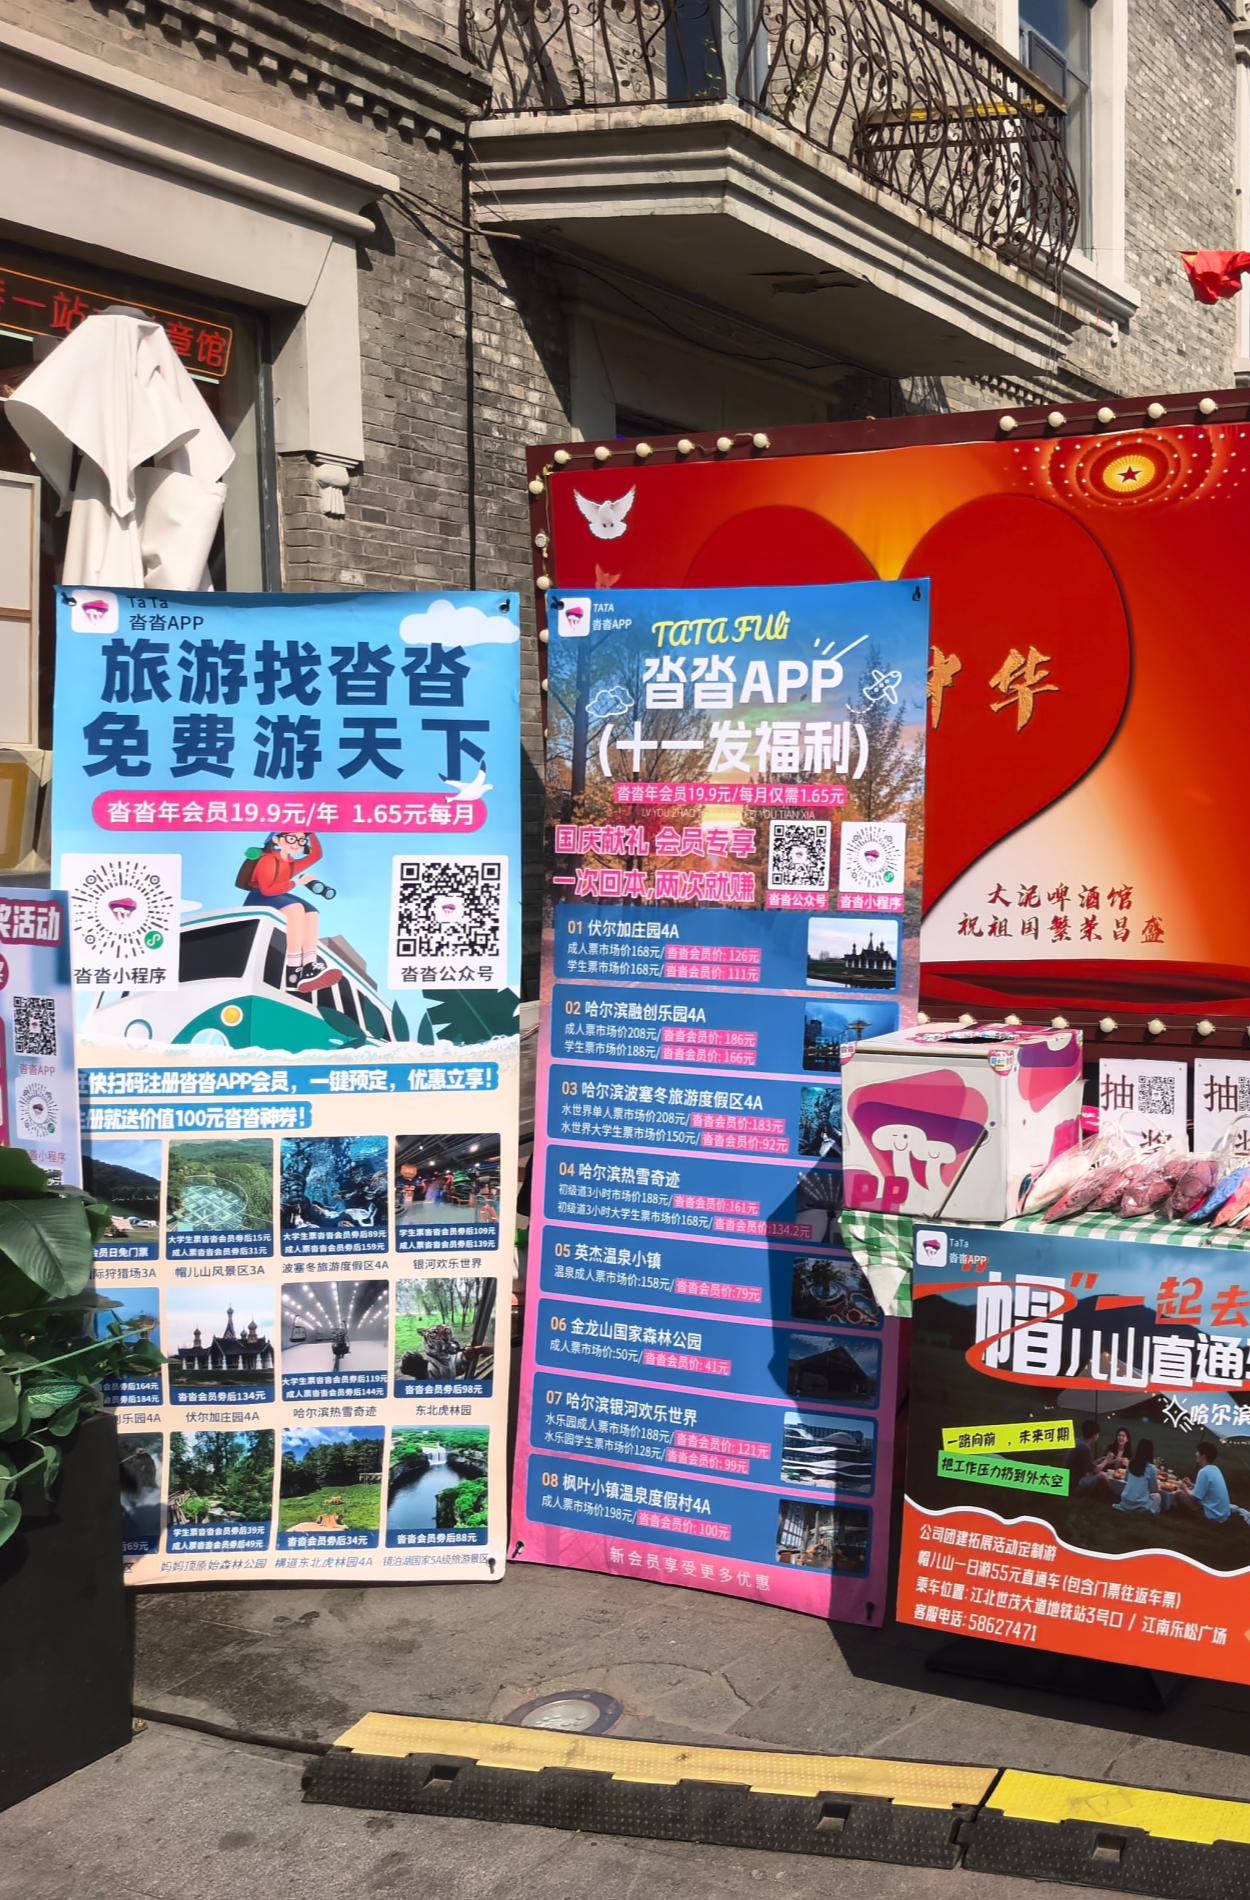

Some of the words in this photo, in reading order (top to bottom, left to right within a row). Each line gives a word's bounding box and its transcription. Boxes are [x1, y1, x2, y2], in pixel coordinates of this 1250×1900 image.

[593, 604, 614, 612] TATA
[129, 615, 204, 631] 沓沓APP
[592, 618, 632, 631] 沓沓APP
[651, 619, 729, 647] TATA
[100, 638, 470, 707] 旅游找沓沓
[642, 655, 844, 710] 沓沓APP
[81, 712, 490, 780] 免费游天下
[599, 721, 869, 779] (十一发福利)
[617, 785, 844, 805] 沓沓年会员19.9元/每月仅需1.65元
[107, 801, 339, 825] 沓沓年会员19.9元/年
[353, 802, 475, 826] 1.65元每月
[554, 825, 649, 855] 国庆献礼
[655, 828, 756, 858] 会员专享
[769, 894, 826, 908] 沓沓公众号
[840, 896, 902, 910] 沓沓小程序
[988, 883, 1134, 911] 大泥啤酒馆
[568, 921, 582, 934] 01
[588, 920, 679, 938] 伏尔加庄园4A
[958, 913, 1165, 944] 祝祖国繁荣昌盛
[73, 967, 167, 984] 沓沓小程序
[401, 966, 495, 982] 沓沓公众号
[565, 1001, 580, 1015] 02
[585, 1002, 706, 1022] 哈尔滨融创乐园4A
[562, 1081, 577, 1095] 03
[582, 1083, 763, 1110] 哈尔滨波塞冬旅游度假区4A
[1101, 1074, 1134, 1111] 抽
[1204, 1075, 1238, 1112] 抽
[559, 1163, 575, 1176] 04
[578, 1164, 680, 1188] 哈尔滨热雪奇迹
[949, 1238, 969, 1248] TaTa
[282, 1261, 389, 1273] 波塞冬旅游度假区4A
[413, 1258, 482, 1269] 银河欢乐世界
[555, 1244, 570, 1258] 05
[575, 1244, 662, 1269] 英杰温泉小镇
[175, 1266, 265, 1278] 帽儿山风景区3A
[551, 1317, 566, 1331] 06
[571, 1317, 702, 1350] 金龙山国家森林公园
[117, 1413, 161, 1424] 乐园4A
[186, 1411, 260, 1423] 伏尔加庄园4A
[294, 1406, 377, 1418] 哈尔滨热雪奇迹
[415, 1405, 472, 1416] 东北虎林园
[546, 1391, 562, 1404] 07
[566, 1392, 697, 1427] 哈尔滨银河欢乐世界
[941, 1457, 1064, 1488] 把工作压力扔到外太空
[542, 1473, 558, 1487] 08
[563, 1474, 711, 1515] 枫叶小镇温泉度假村4A
[920, 1523, 1057, 1561] 公司团建拓展活动定制游
[160, 1558, 267, 1572] 妈妈顶原始森林公园
[610, 1547, 771, 1592] 新会员享受更多优惠
